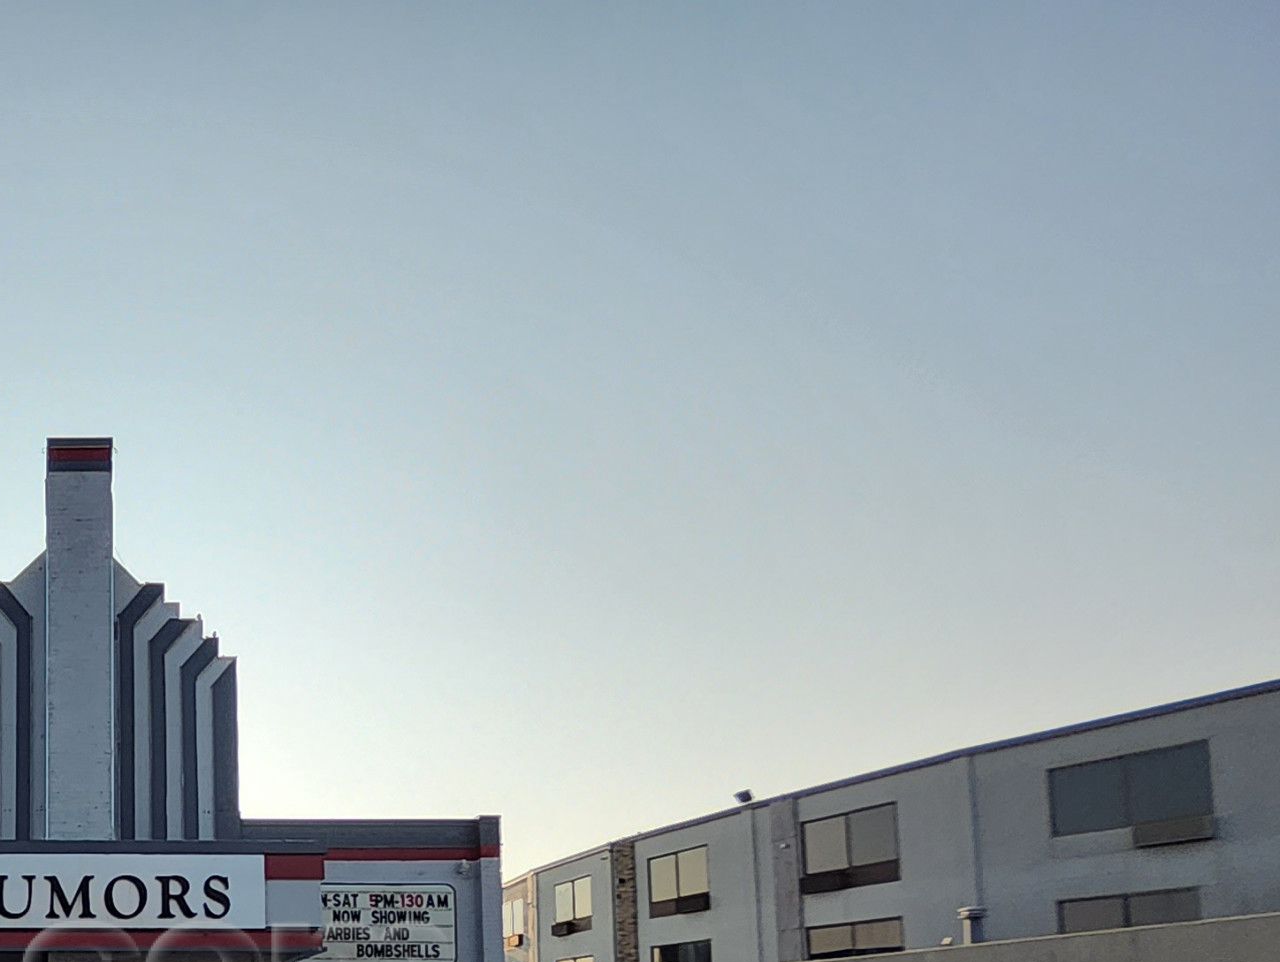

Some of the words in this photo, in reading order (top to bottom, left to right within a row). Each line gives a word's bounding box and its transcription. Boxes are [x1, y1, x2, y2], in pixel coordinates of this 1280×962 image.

[333, 910, 361, 922] NOW
[372, 910, 430, 924] SHOWING
[384, 927, 410, 940] AND
[357, 944, 441, 958] BOMBSHELLS
